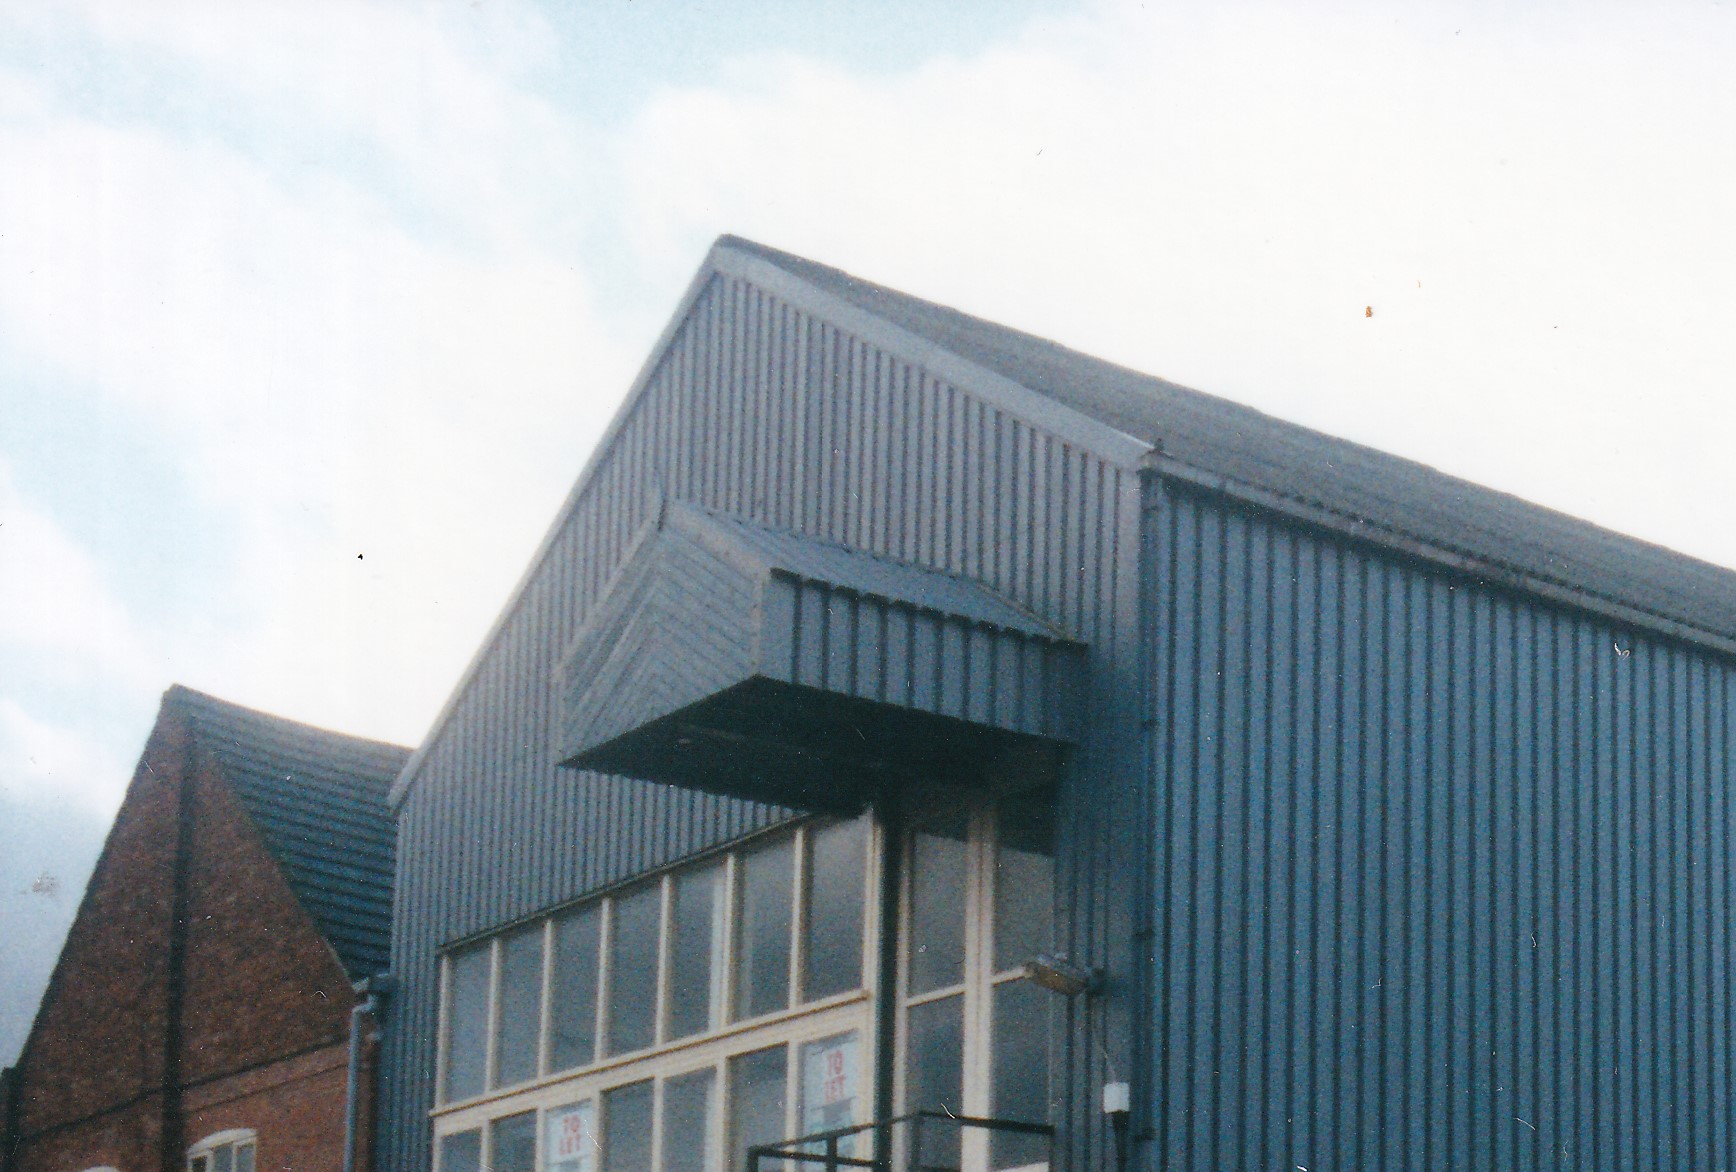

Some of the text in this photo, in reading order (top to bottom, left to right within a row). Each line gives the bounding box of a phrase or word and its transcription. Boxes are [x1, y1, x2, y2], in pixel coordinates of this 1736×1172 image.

[827, 1050, 844, 1075] TO
[824, 1073, 847, 1102] LET
[563, 1113, 581, 1135] TO
[560, 1133, 580, 1155] LET
